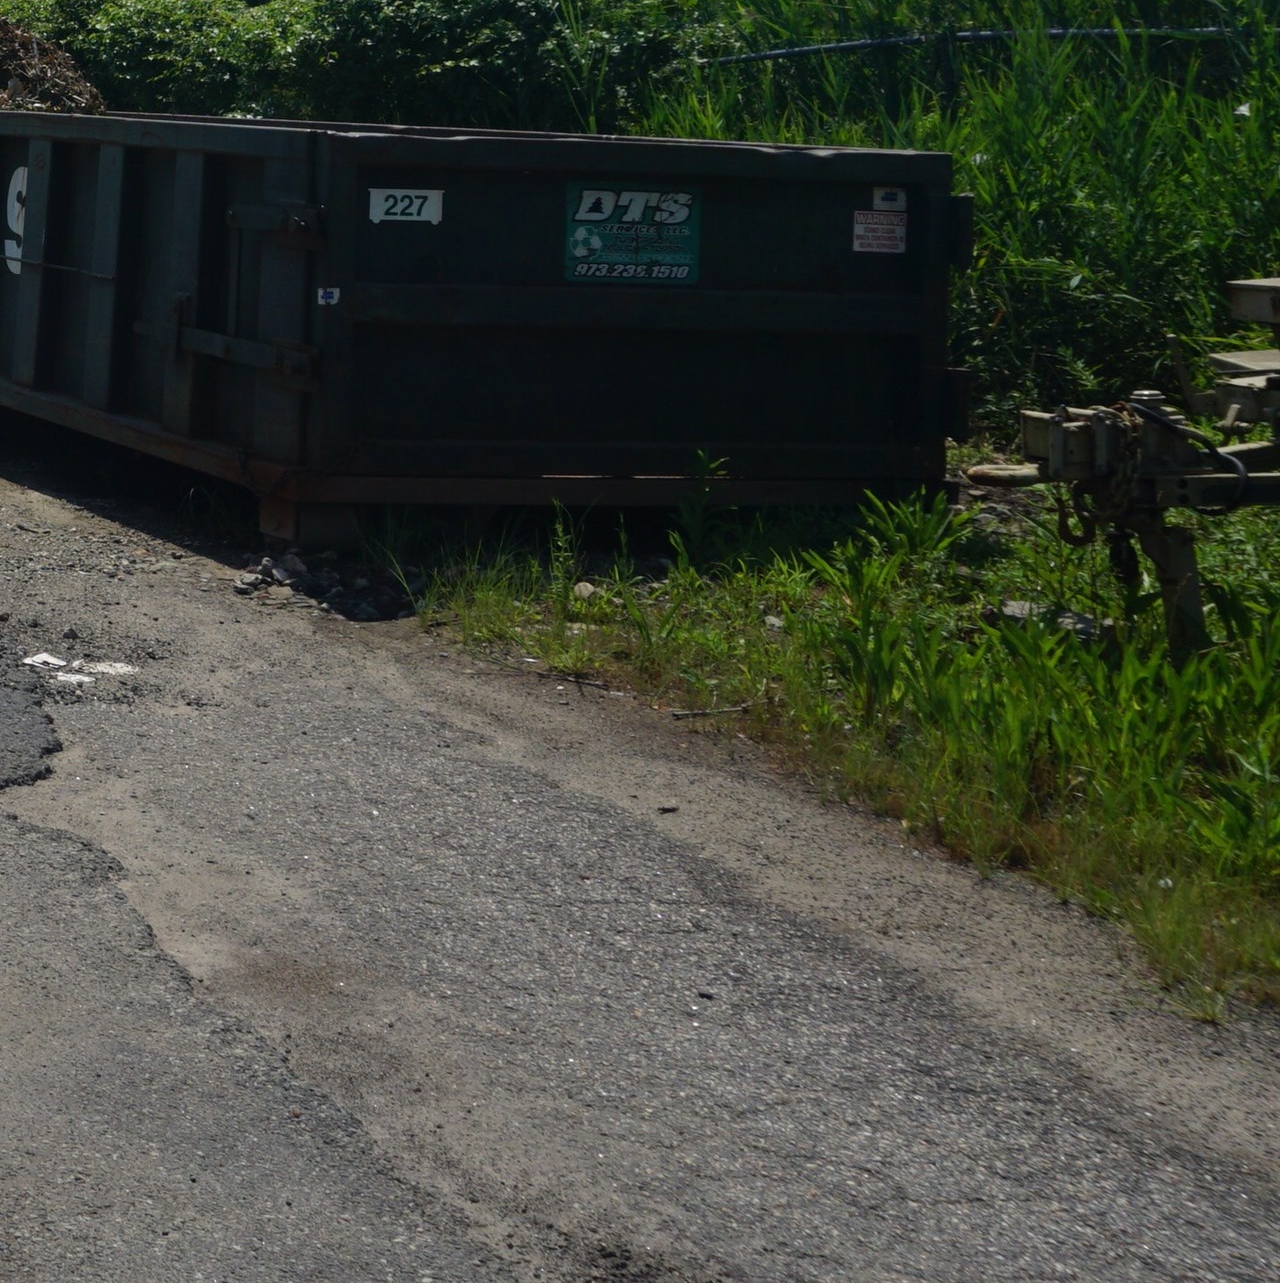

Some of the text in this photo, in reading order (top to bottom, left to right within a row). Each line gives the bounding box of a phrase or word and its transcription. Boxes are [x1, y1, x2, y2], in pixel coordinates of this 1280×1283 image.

[384, 194, 429, 217] 227
[573, 190, 694, 224] DTS
[856, 214, 905, 226] WARNING
